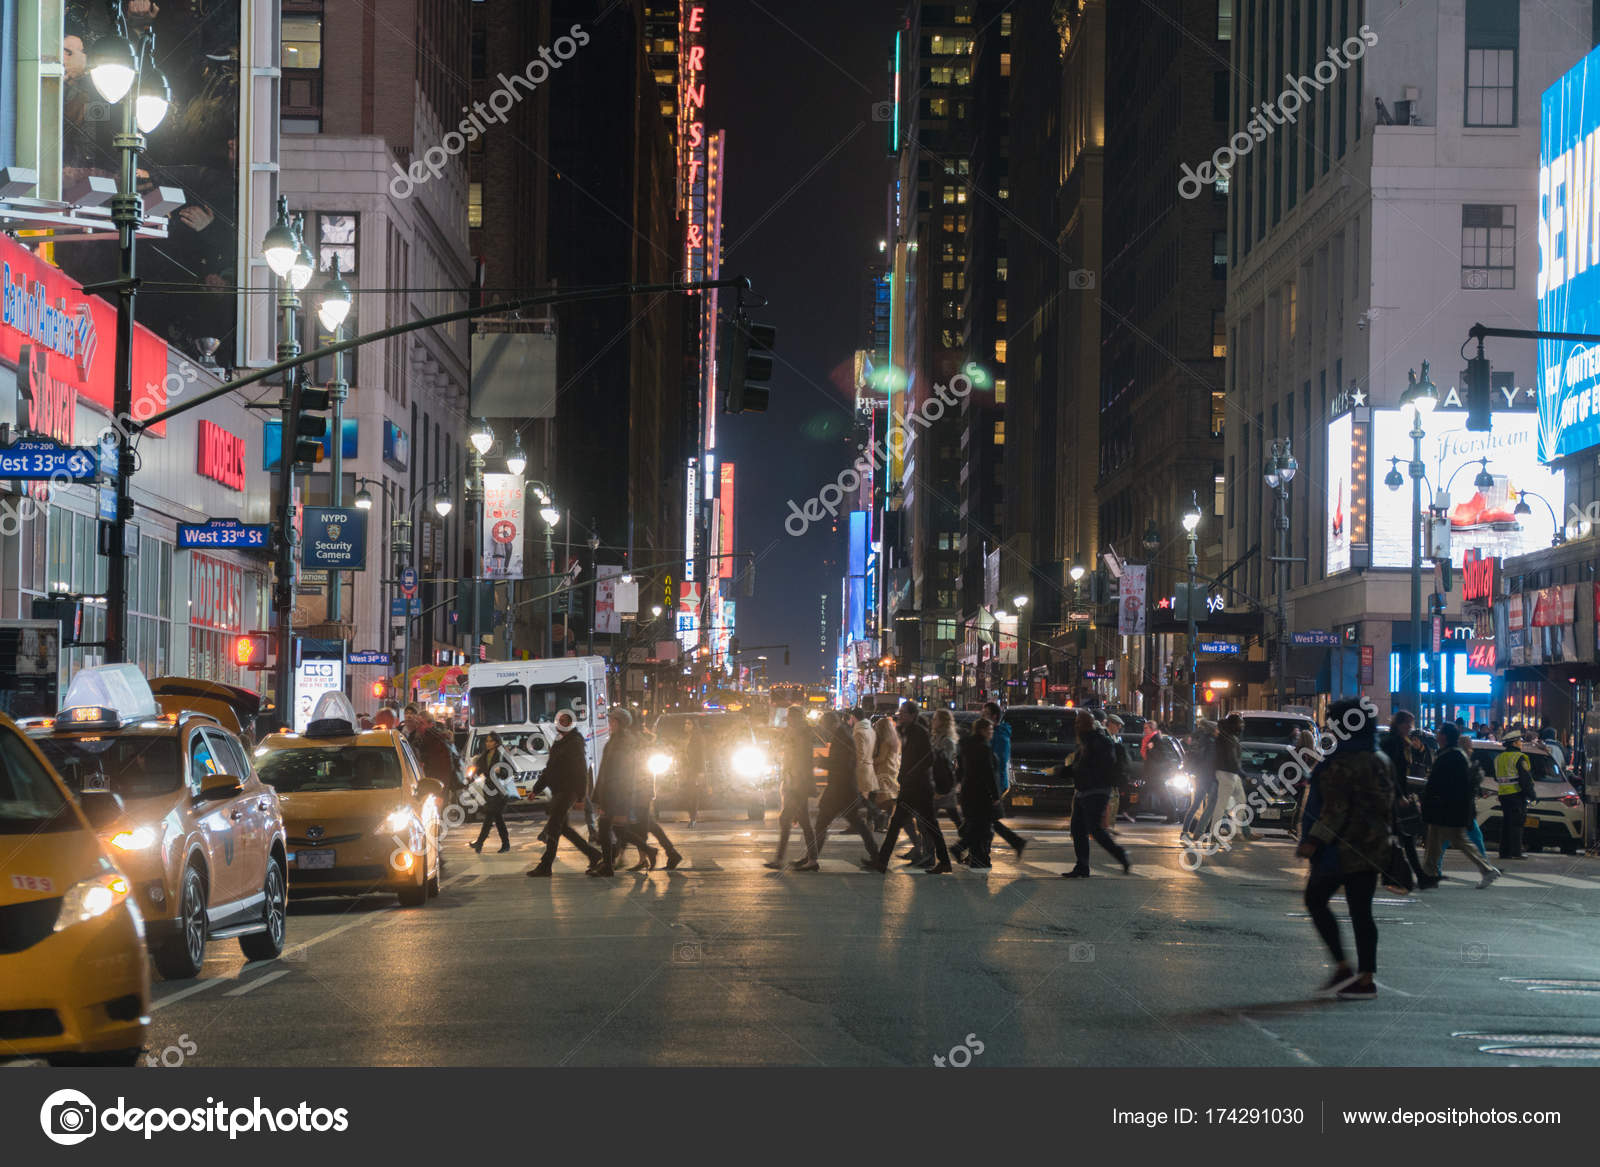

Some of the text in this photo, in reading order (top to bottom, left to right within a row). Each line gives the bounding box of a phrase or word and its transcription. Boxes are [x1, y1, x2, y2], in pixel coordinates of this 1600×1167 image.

[38, 284, 75, 360] America
[0, 454, 28, 472] est
[33, 453, 66, 472] 33rd
[70, 454, 88, 472] St
[321, 514, 347, 523] NYPD
[184, 529, 263, 543] West 33rd St
[315, 541, 352, 552] Security
[316, 550, 351, 559] Camera
[1295, 634, 1313, 643] West
[1330, 635, 1338, 644] St
[1202, 643, 1218, 652] West
[1230, 644, 1238, 653] St
[350, 655, 367, 663] West
